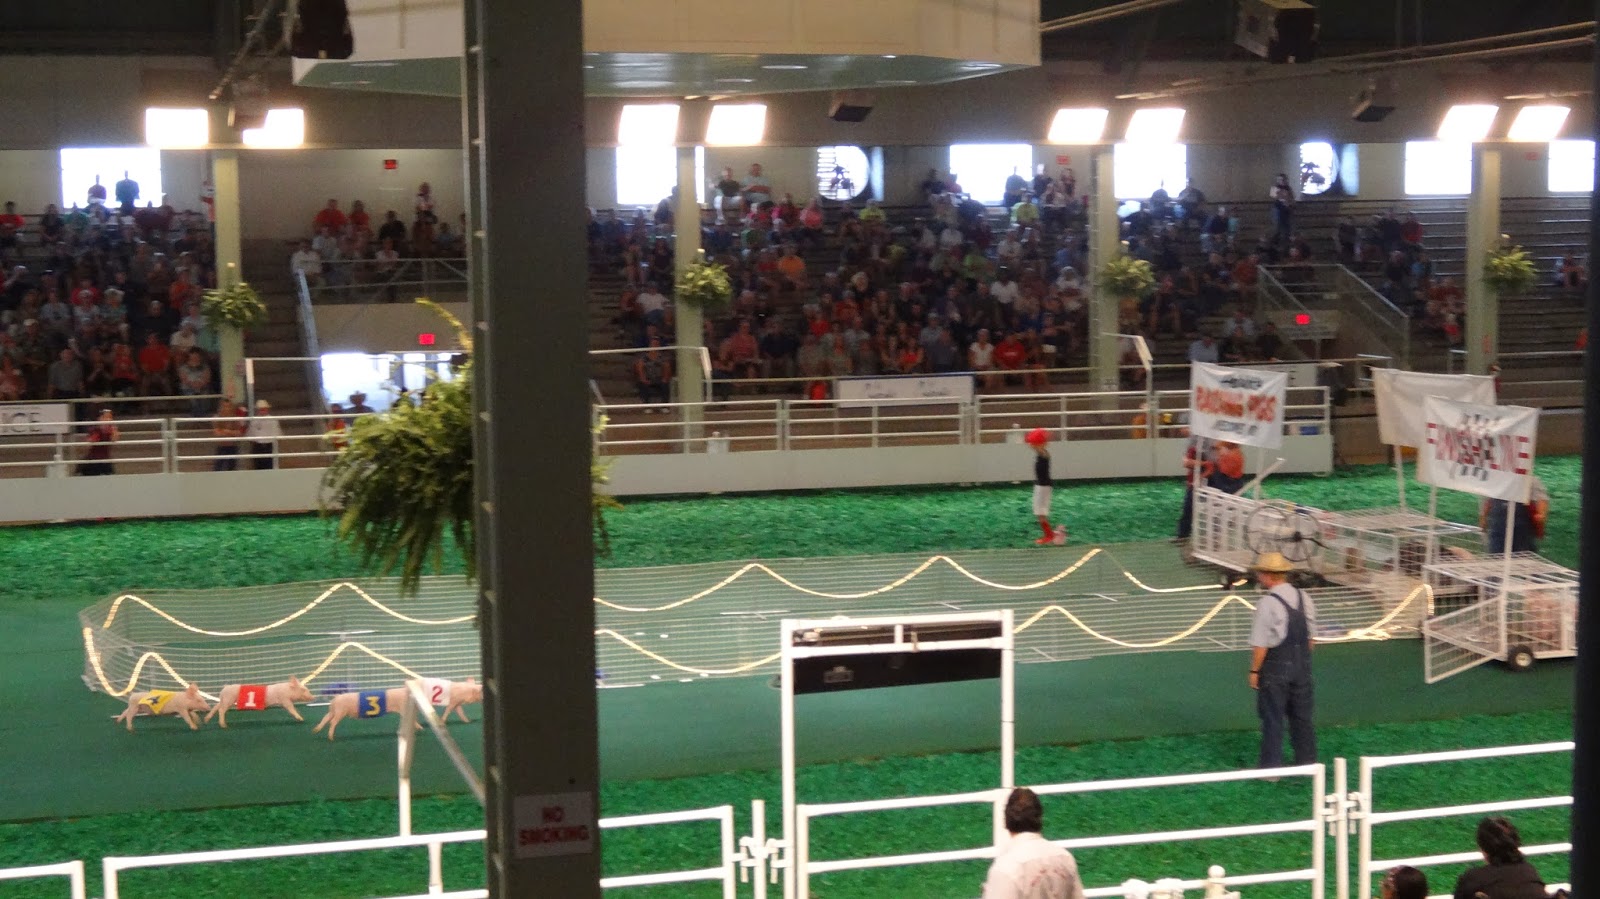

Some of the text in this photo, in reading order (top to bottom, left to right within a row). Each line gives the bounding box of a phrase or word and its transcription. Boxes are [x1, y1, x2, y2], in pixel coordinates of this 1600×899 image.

[245, 691, 257, 707] 1
[431, 685, 444, 703] 2
[365, 696, 381, 716] 3
[542, 806, 564, 823] NO
[519, 825, 590, 846] SMOKING
